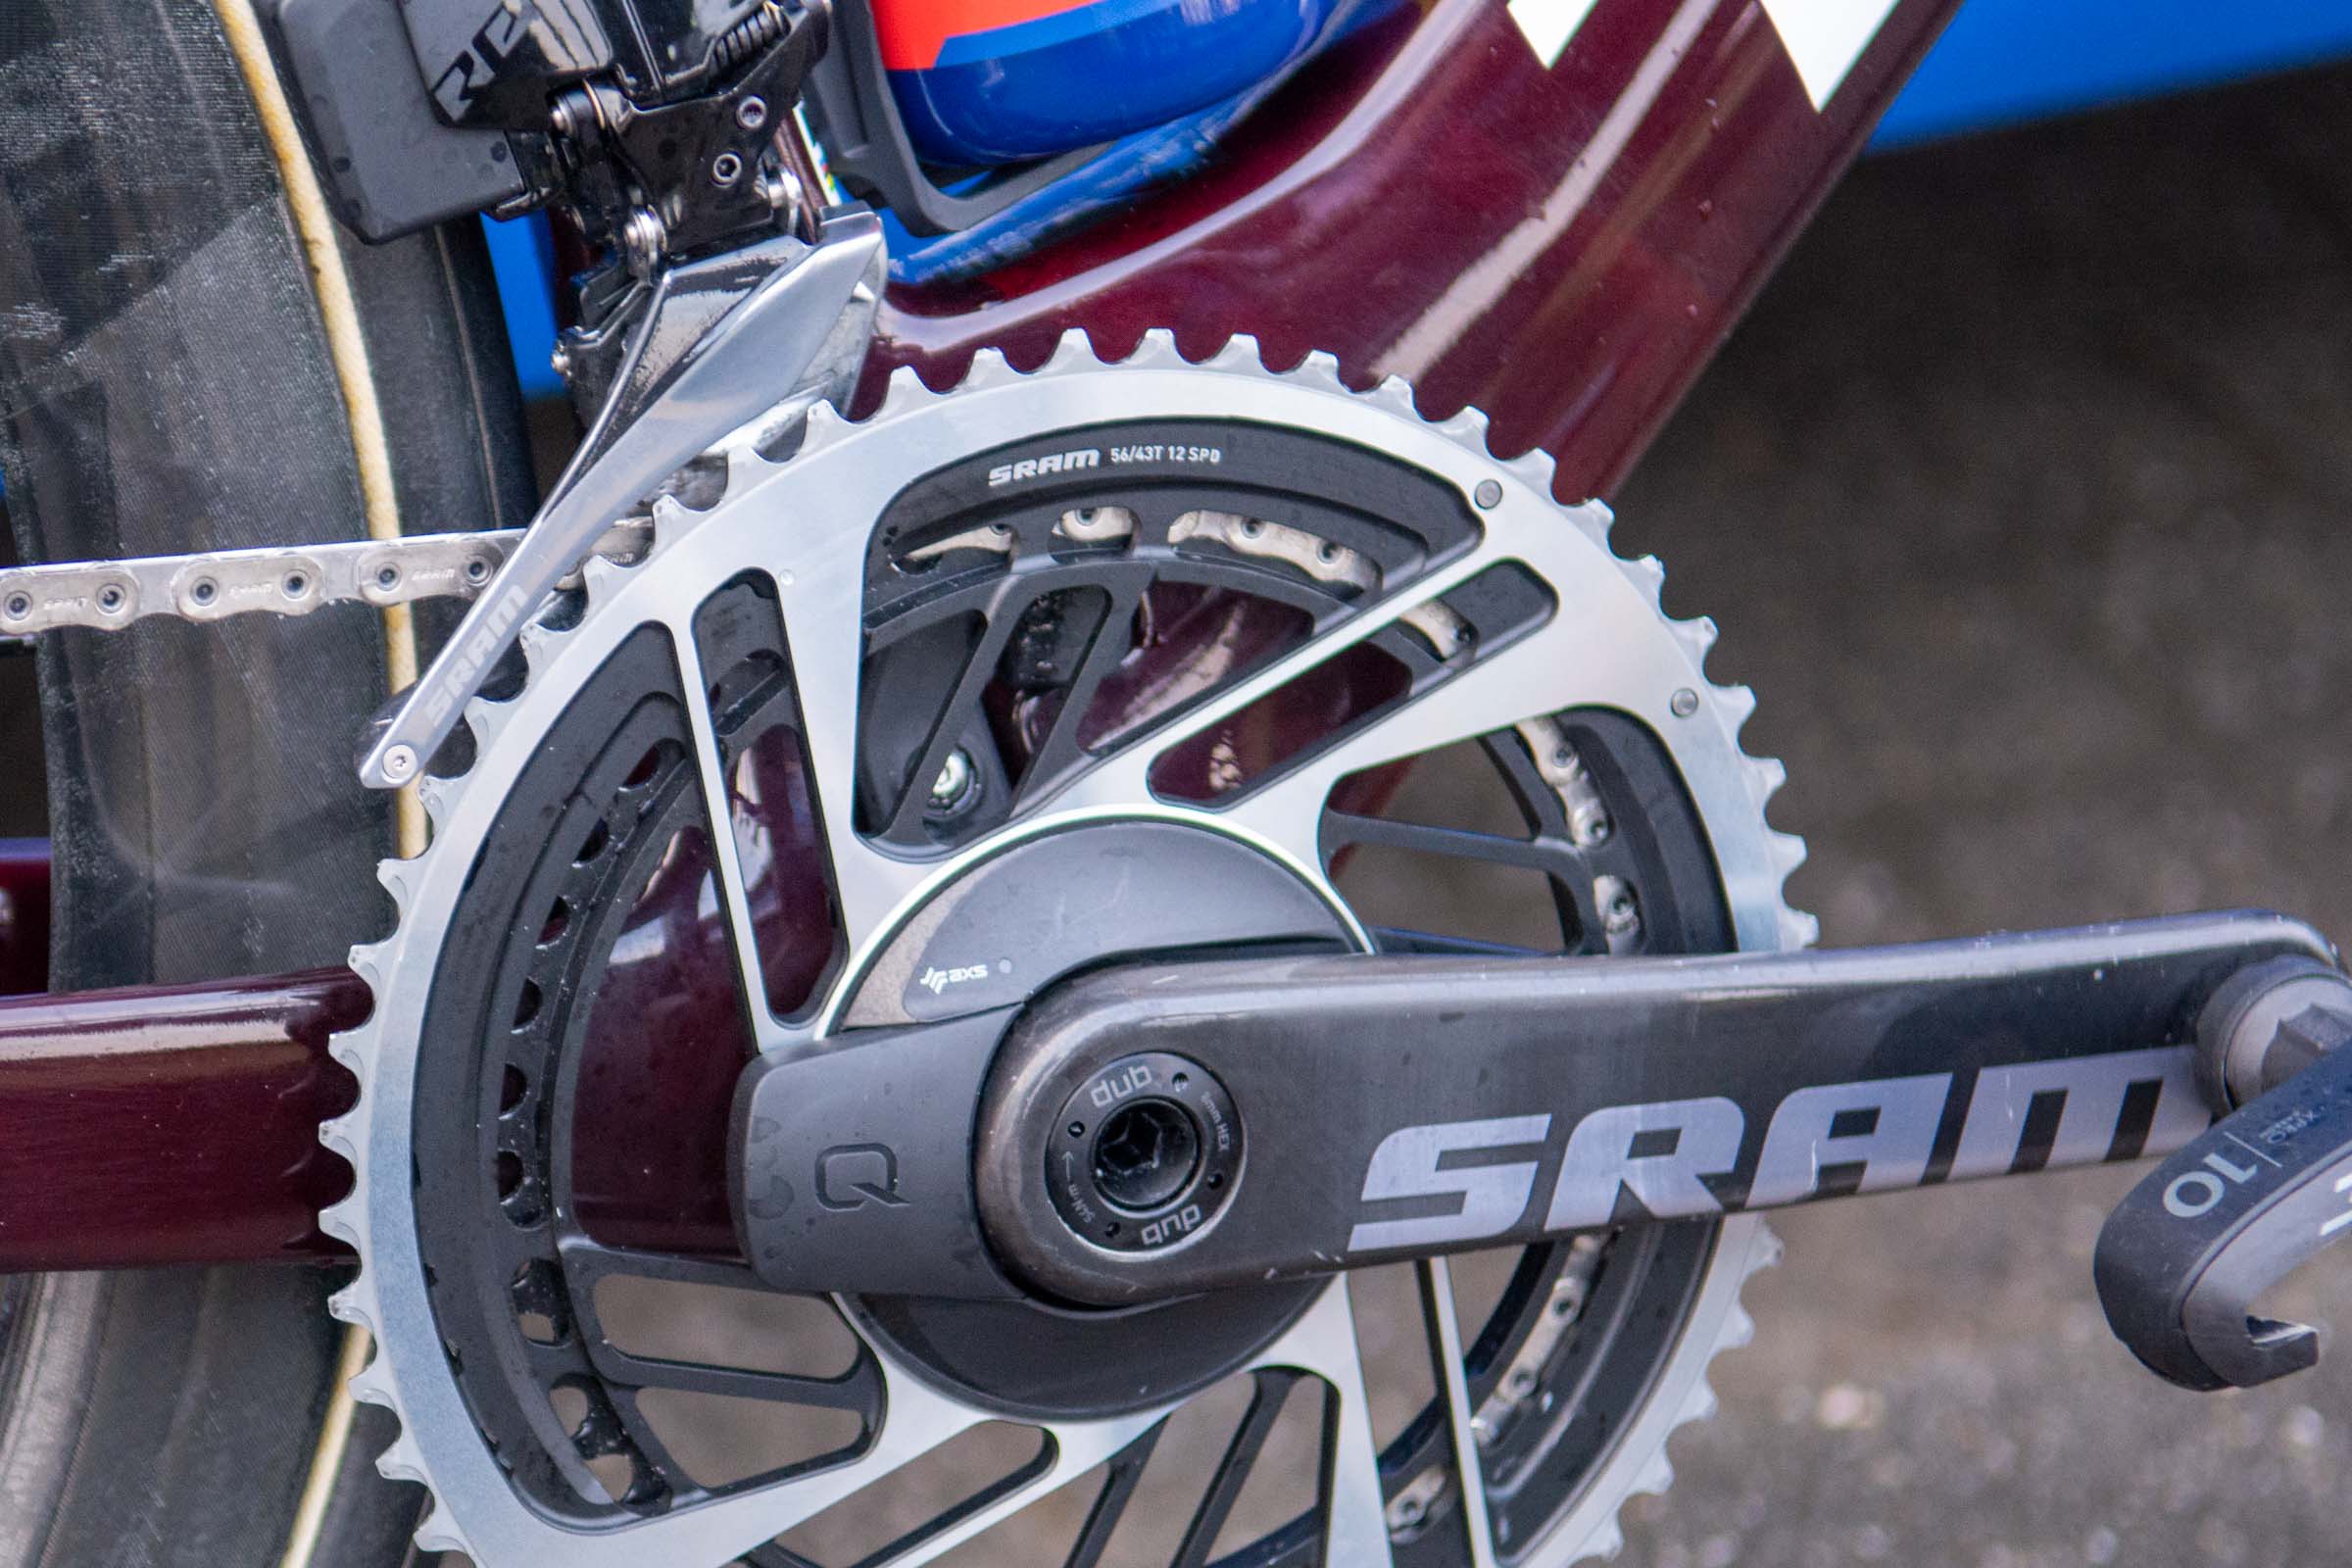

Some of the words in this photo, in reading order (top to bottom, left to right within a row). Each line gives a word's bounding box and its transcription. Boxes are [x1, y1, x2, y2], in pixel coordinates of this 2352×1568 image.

[988, 448, 1101, 487] SRAM
[1109, 445, 1163, 464] 56/43T
[1168, 446, 1185, 463] 12
[422, 585, 529, 727] SRAM
[814, 1142, 910, 1211] Q
[1348, 1044, 2212, 1252] SRAM
